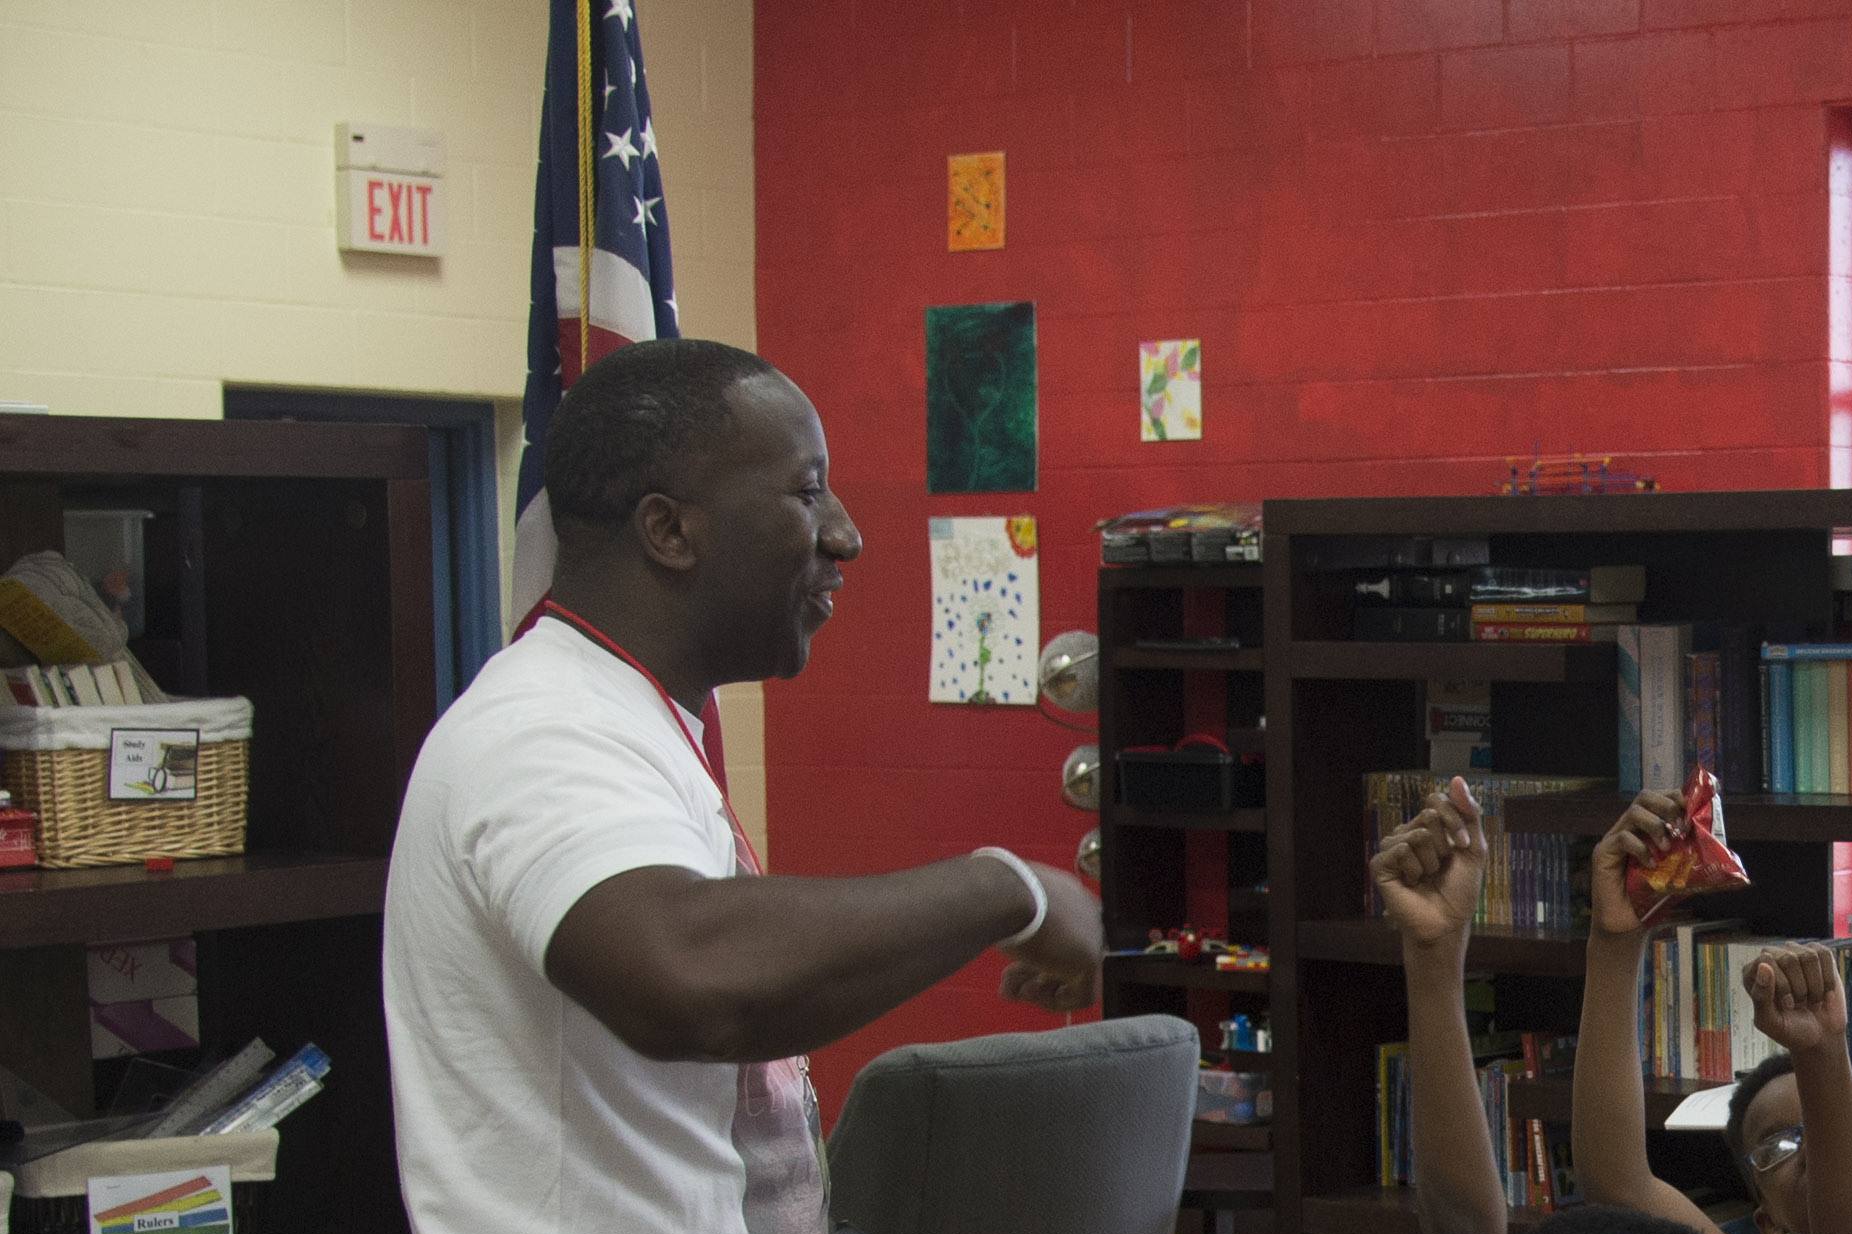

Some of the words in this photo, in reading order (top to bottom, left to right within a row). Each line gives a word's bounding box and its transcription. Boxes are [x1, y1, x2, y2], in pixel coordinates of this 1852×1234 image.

[366, 180, 432, 246] EXIT
[123, 740, 145, 750] Study
[127, 754, 143, 762] Aids
[137, 1216, 174, 1229] Rulers
